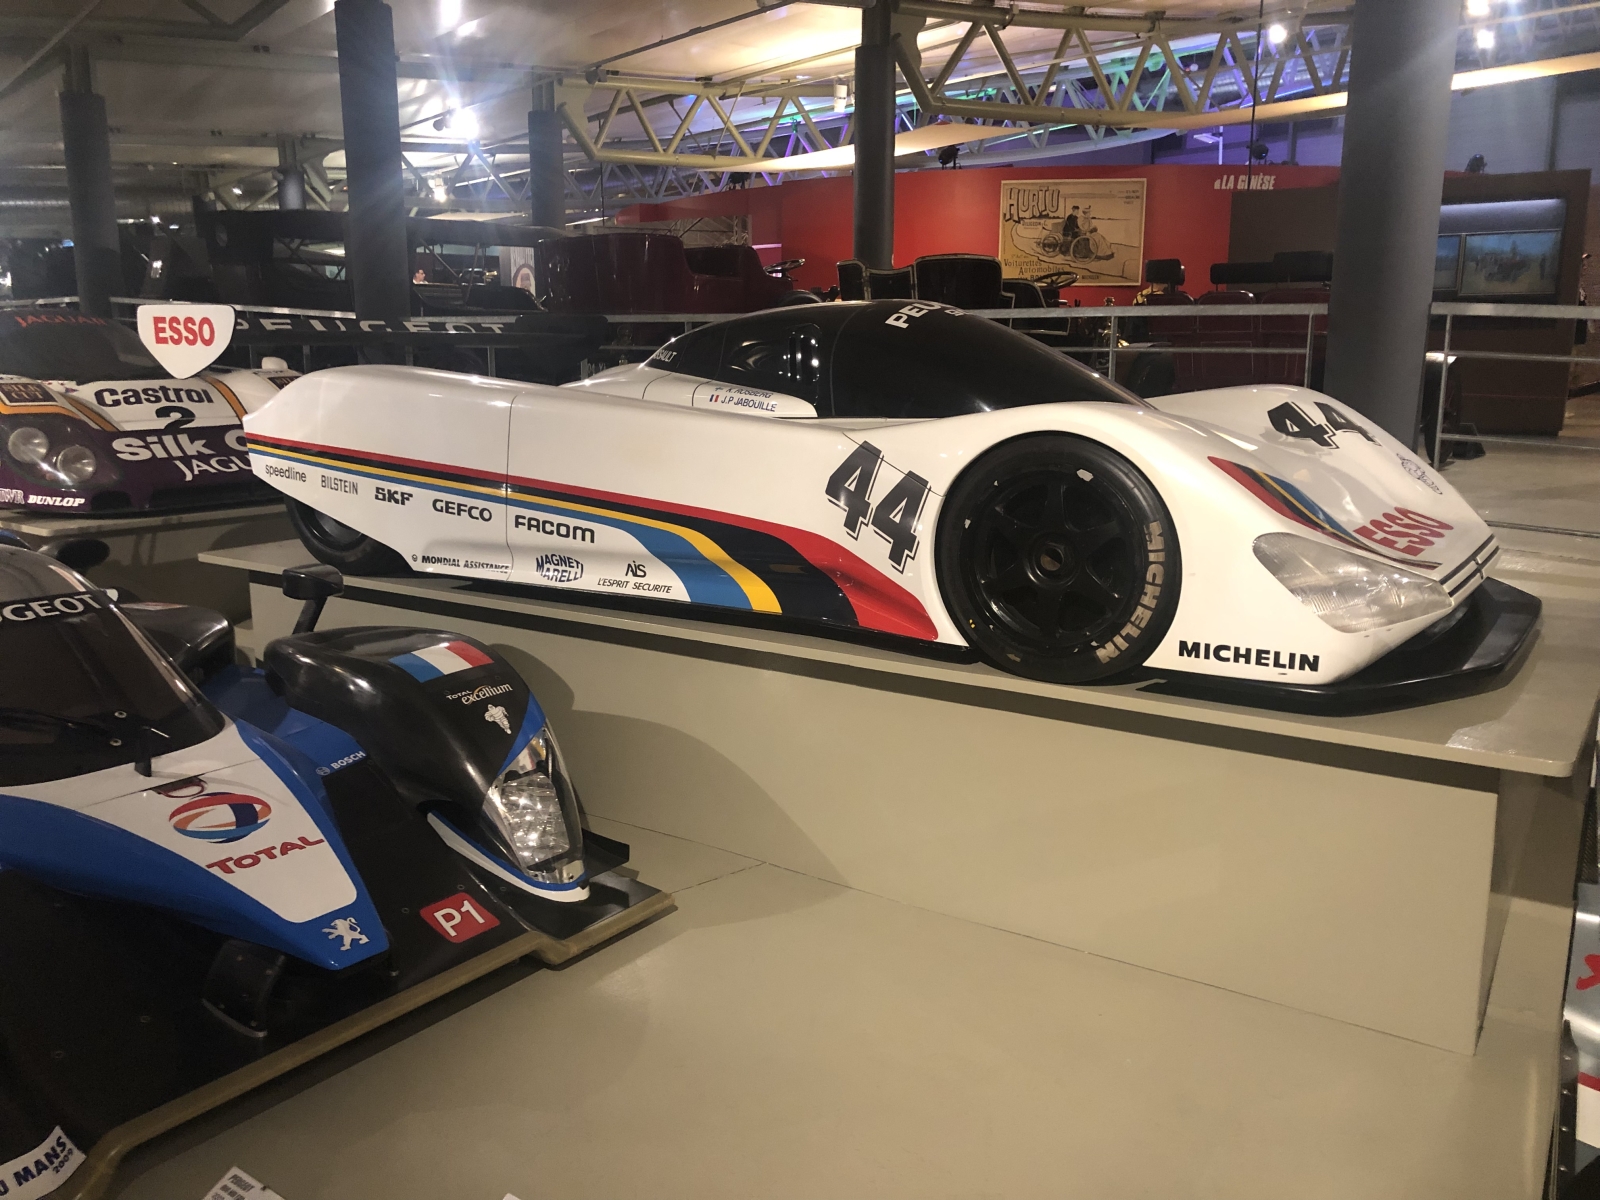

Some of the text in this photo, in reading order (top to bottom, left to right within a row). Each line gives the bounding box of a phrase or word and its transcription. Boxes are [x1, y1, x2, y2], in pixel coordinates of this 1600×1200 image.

[1221, 175, 1235, 190] LA
[1003, 186, 1060, 224] HURTU
[1003, 258, 1043, 267] Voiturettes
[1018, 266, 1065, 276] Automobiles
[152, 316, 216, 347] ESSO
[94, 386, 214, 408] Castrol
[155, 405, 196, 431] 2
[1267, 401, 1382, 450] 44
[112, 433, 216, 461] Silk
[265, 463, 307, 483] speedline
[320, 474, 358, 496] BILSTEIN
[27, 495, 85, 507] DUNLOP
[374, 486, 413, 506] SKF
[825, 440, 931, 574] 44
[432, 498, 492, 522] GEFCO
[514, 514, 595, 544] FACOM
[1352, 506, 1454, 557] ESSO
[421, 555, 461, 568] MONDIAL
[597, 577, 673, 594] L'ESPRIT SECURITE
[1095, 520, 1165, 664] MICHELIN
[0, 594, 102, 622] GEOT
[1178, 640, 1320, 672] MICHELIN
[446, 690, 473, 700] TOTAL
[461, 683, 513, 705] excellium
[330, 750, 367, 769] BOSCH
[205, 836, 325, 875] TOTAL
[433, 899, 486, 938] P1
[13, 1135, 66, 1187] MANS
[52, 1147, 74, 1174] 2009
